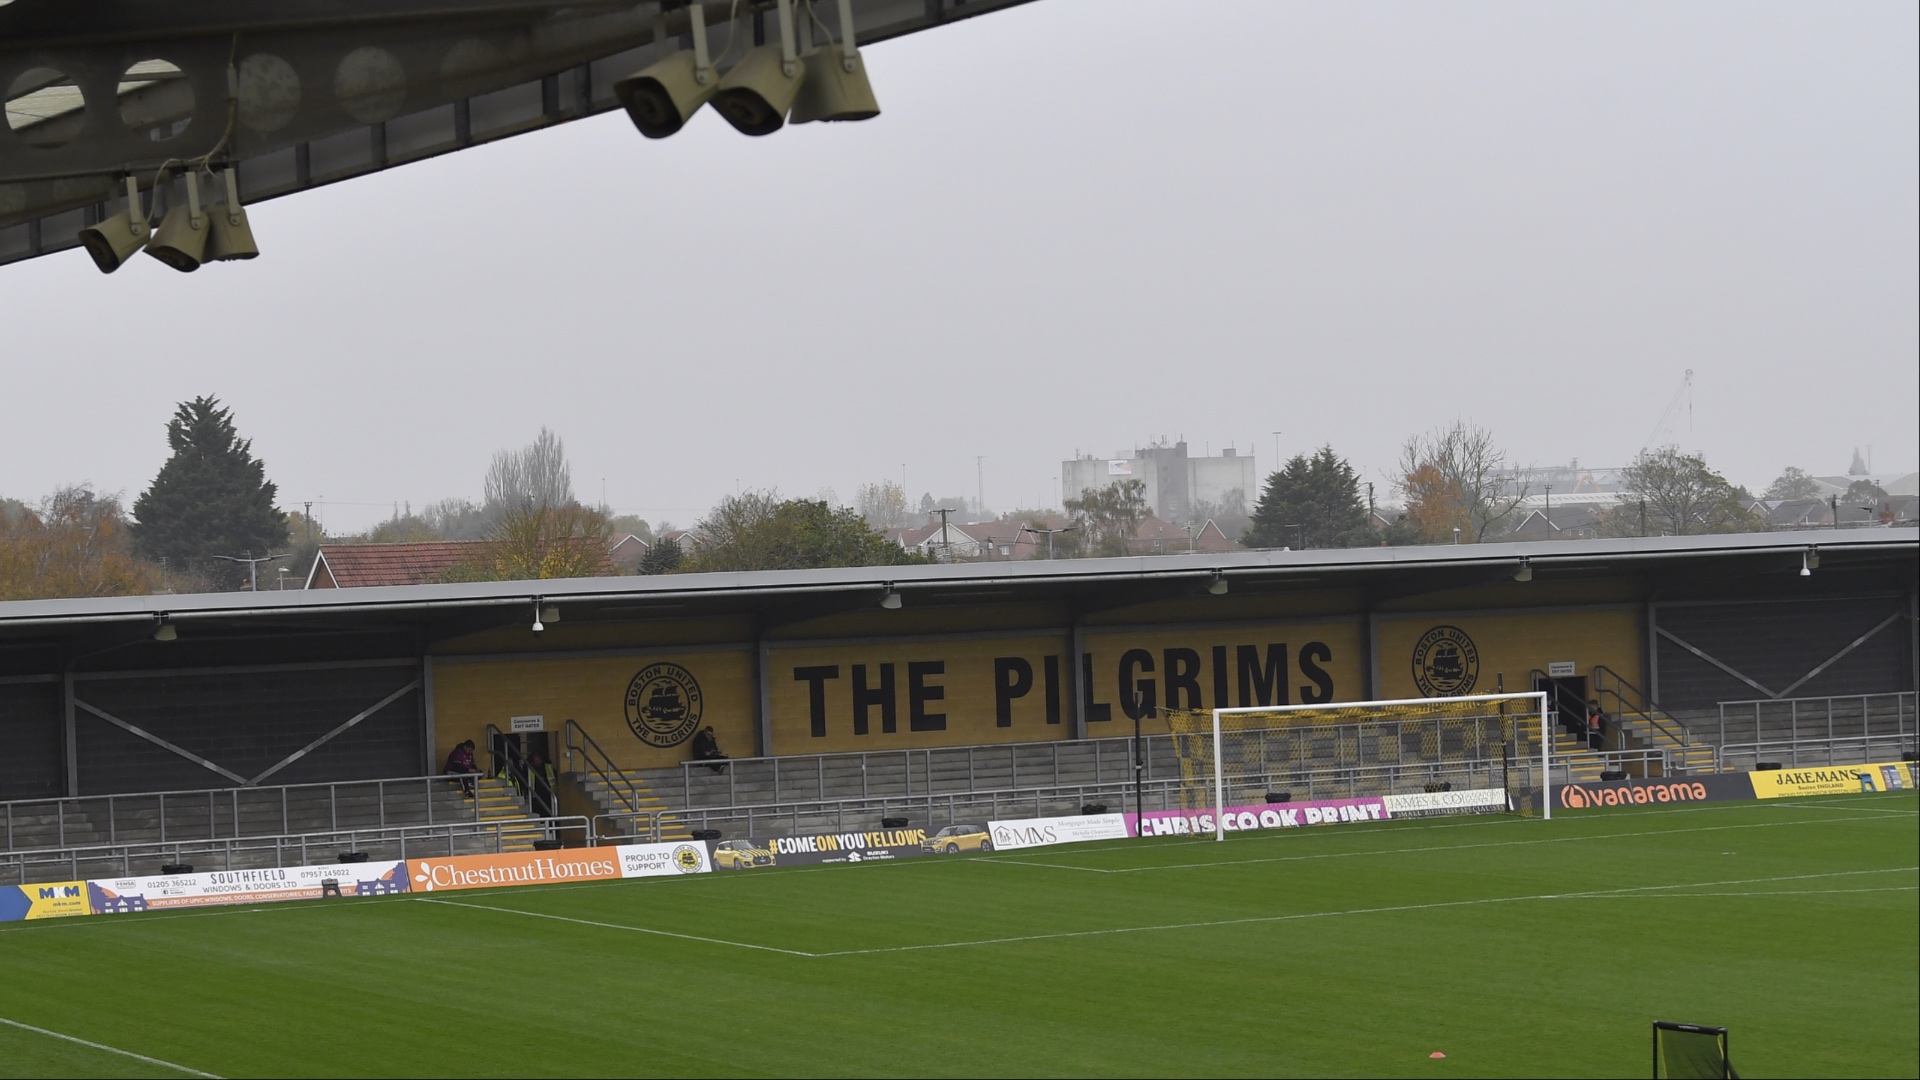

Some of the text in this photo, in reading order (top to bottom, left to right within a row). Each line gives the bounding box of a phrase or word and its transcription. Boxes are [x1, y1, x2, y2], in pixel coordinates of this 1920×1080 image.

[1415, 629, 1476, 665] BOSTON UNITED
[628, 667, 698, 707] BOSTON UNITED
[793, 641, 1334, 738] THE PILGRIMS
[1419, 675, 1433, 695] THE
[632, 713, 698, 744] THE PILGRIMS
[1776, 769, 1861, 785] JAKEMANS
[1389, 796, 1429, 809] JAMES
[1588, 782, 1707, 807] vanarama
[1136, 803, 1381, 836] CHRIS COOK PRINT
[1397, 810, 1422, 818] SMALL
[769, 829, 926, 855] #COMEONYOUYELLOWS
[625, 854, 656, 862] PROUD
[627, 862, 666, 872] SUPPORT
[210, 869, 286, 884] SOUTHFIELD
[432, 858, 614, 887] ChestnutHomes
[172, 879, 197, 887] 365212
[202, 885, 242, 893] WINDOWS
[254, 882, 281, 890] DOORS
[39, 886, 80, 899] MKM
